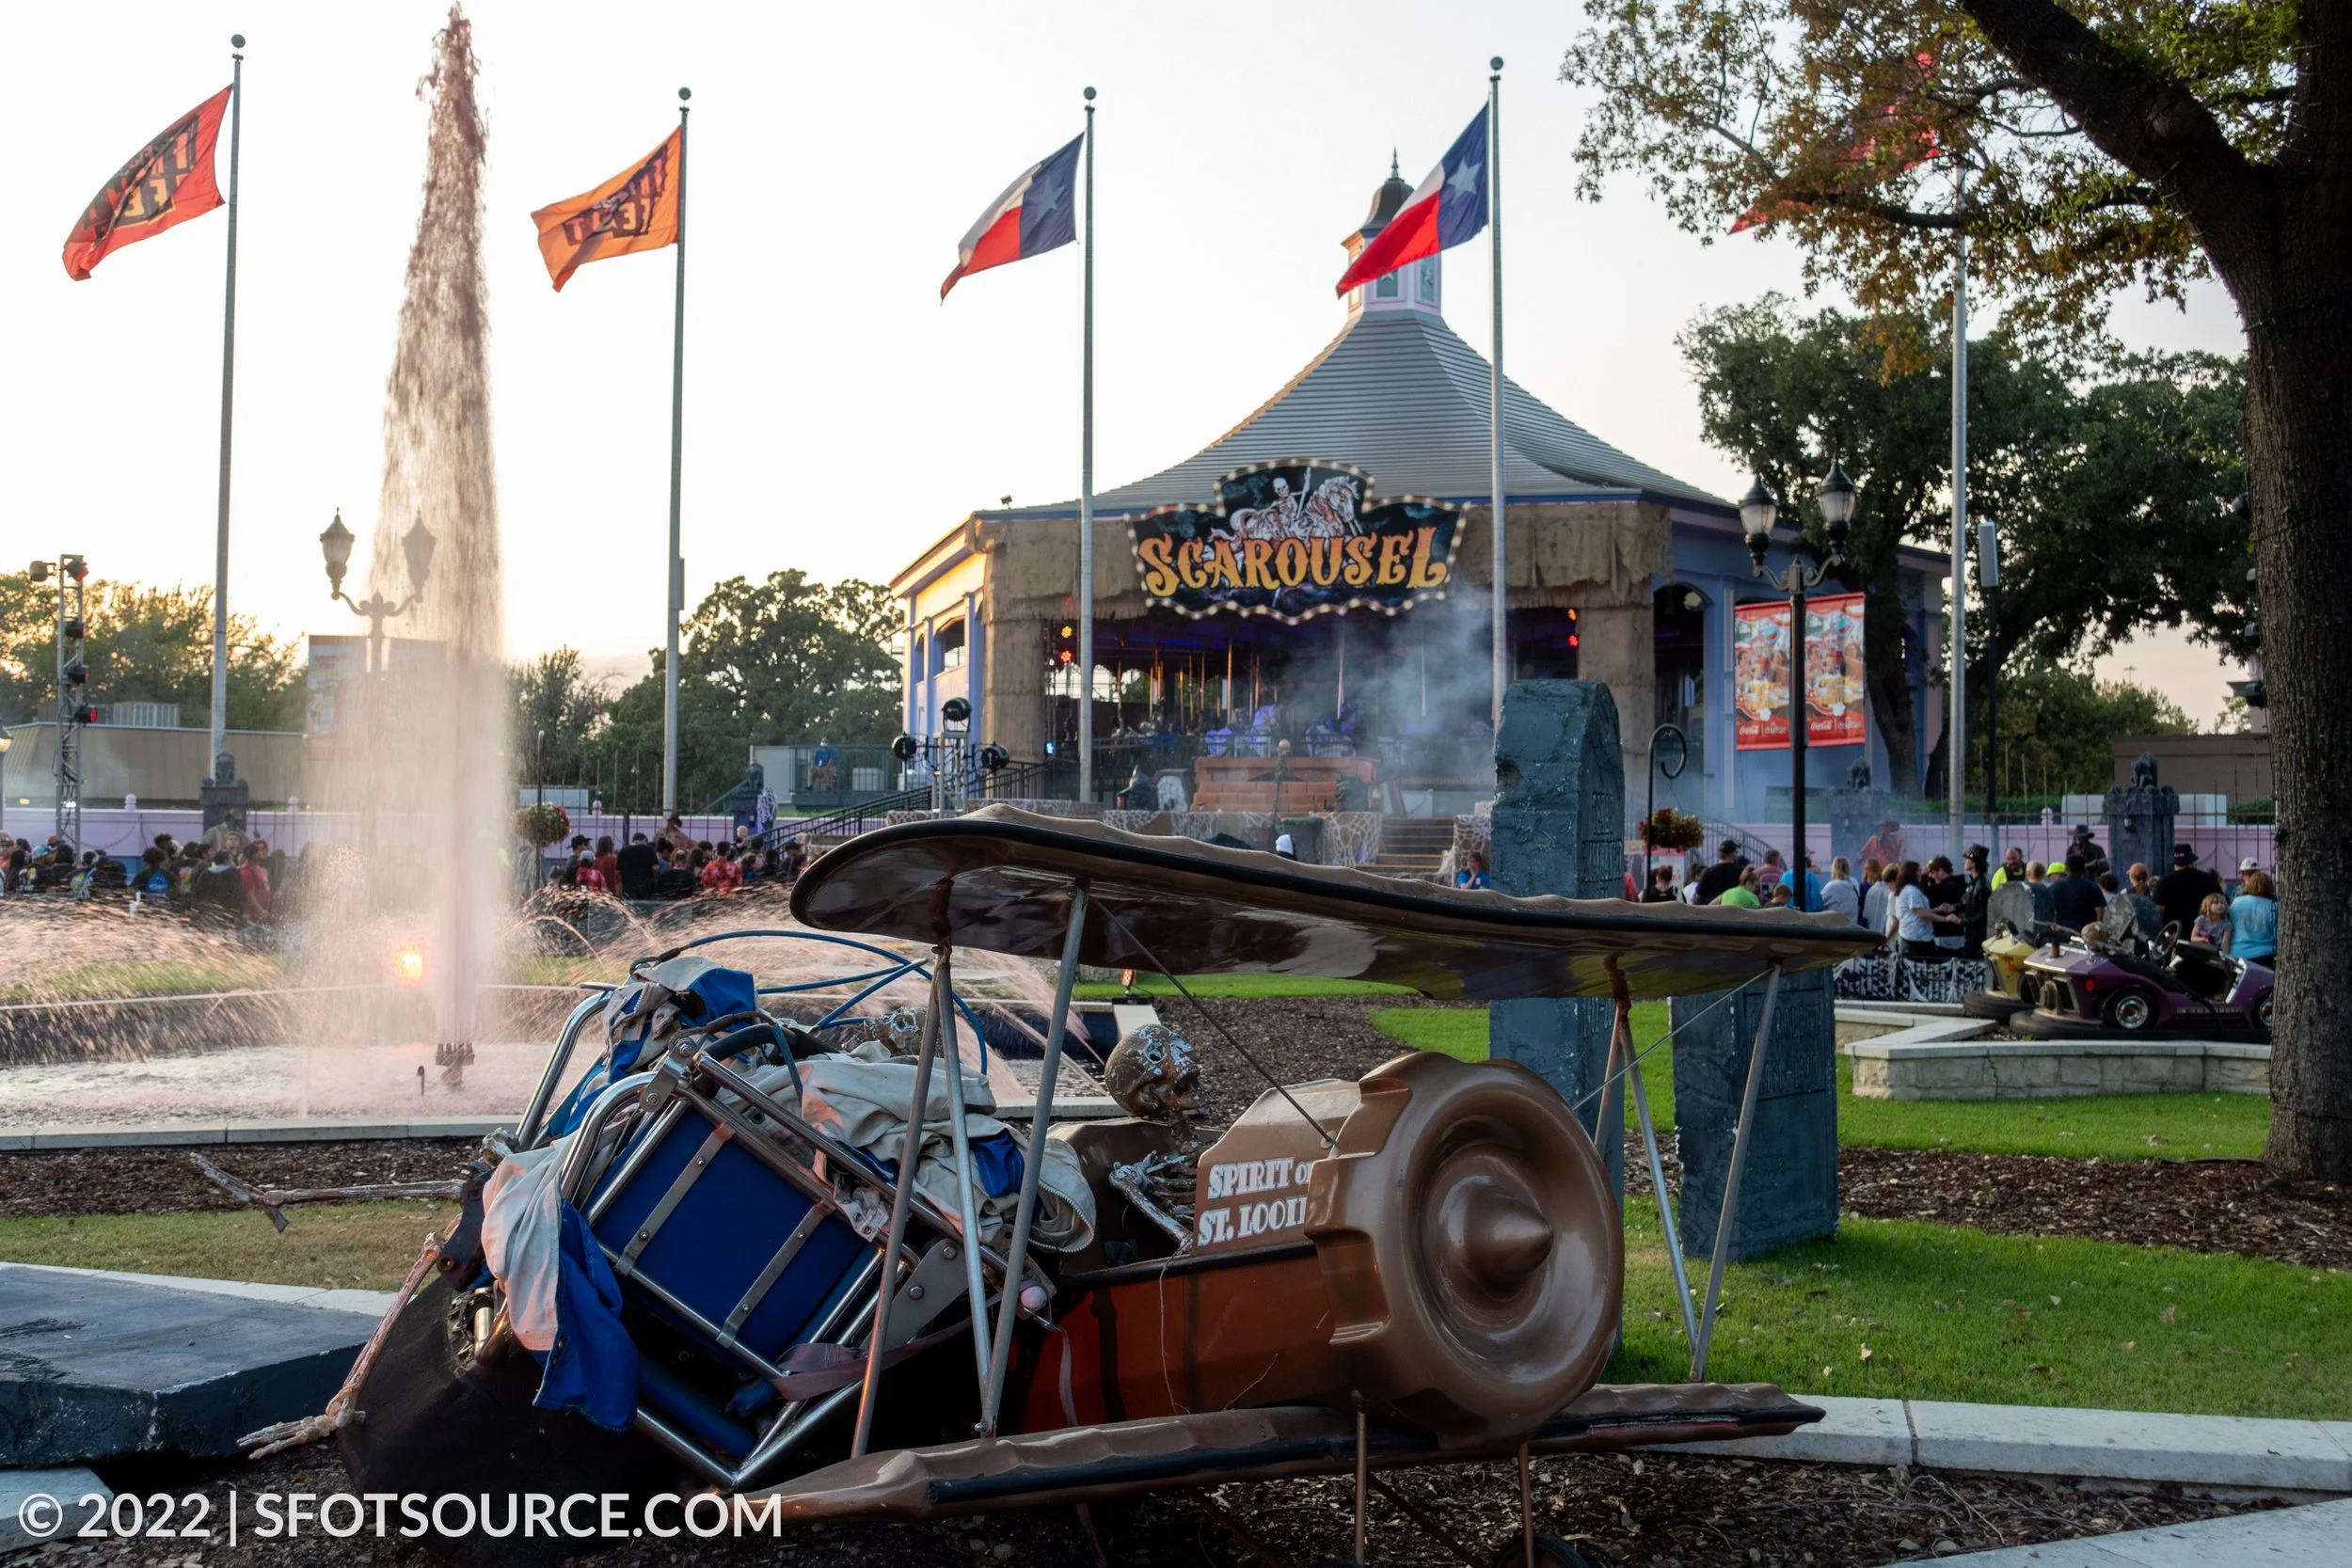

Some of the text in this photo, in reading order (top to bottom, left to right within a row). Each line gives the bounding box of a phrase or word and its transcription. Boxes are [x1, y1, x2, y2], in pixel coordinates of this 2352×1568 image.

[1138, 527, 1447, 597] SCAROUSEL
[1207, 1157, 1295, 1199] SPIRIT
[1198, 1207, 1234, 1247] ST.
